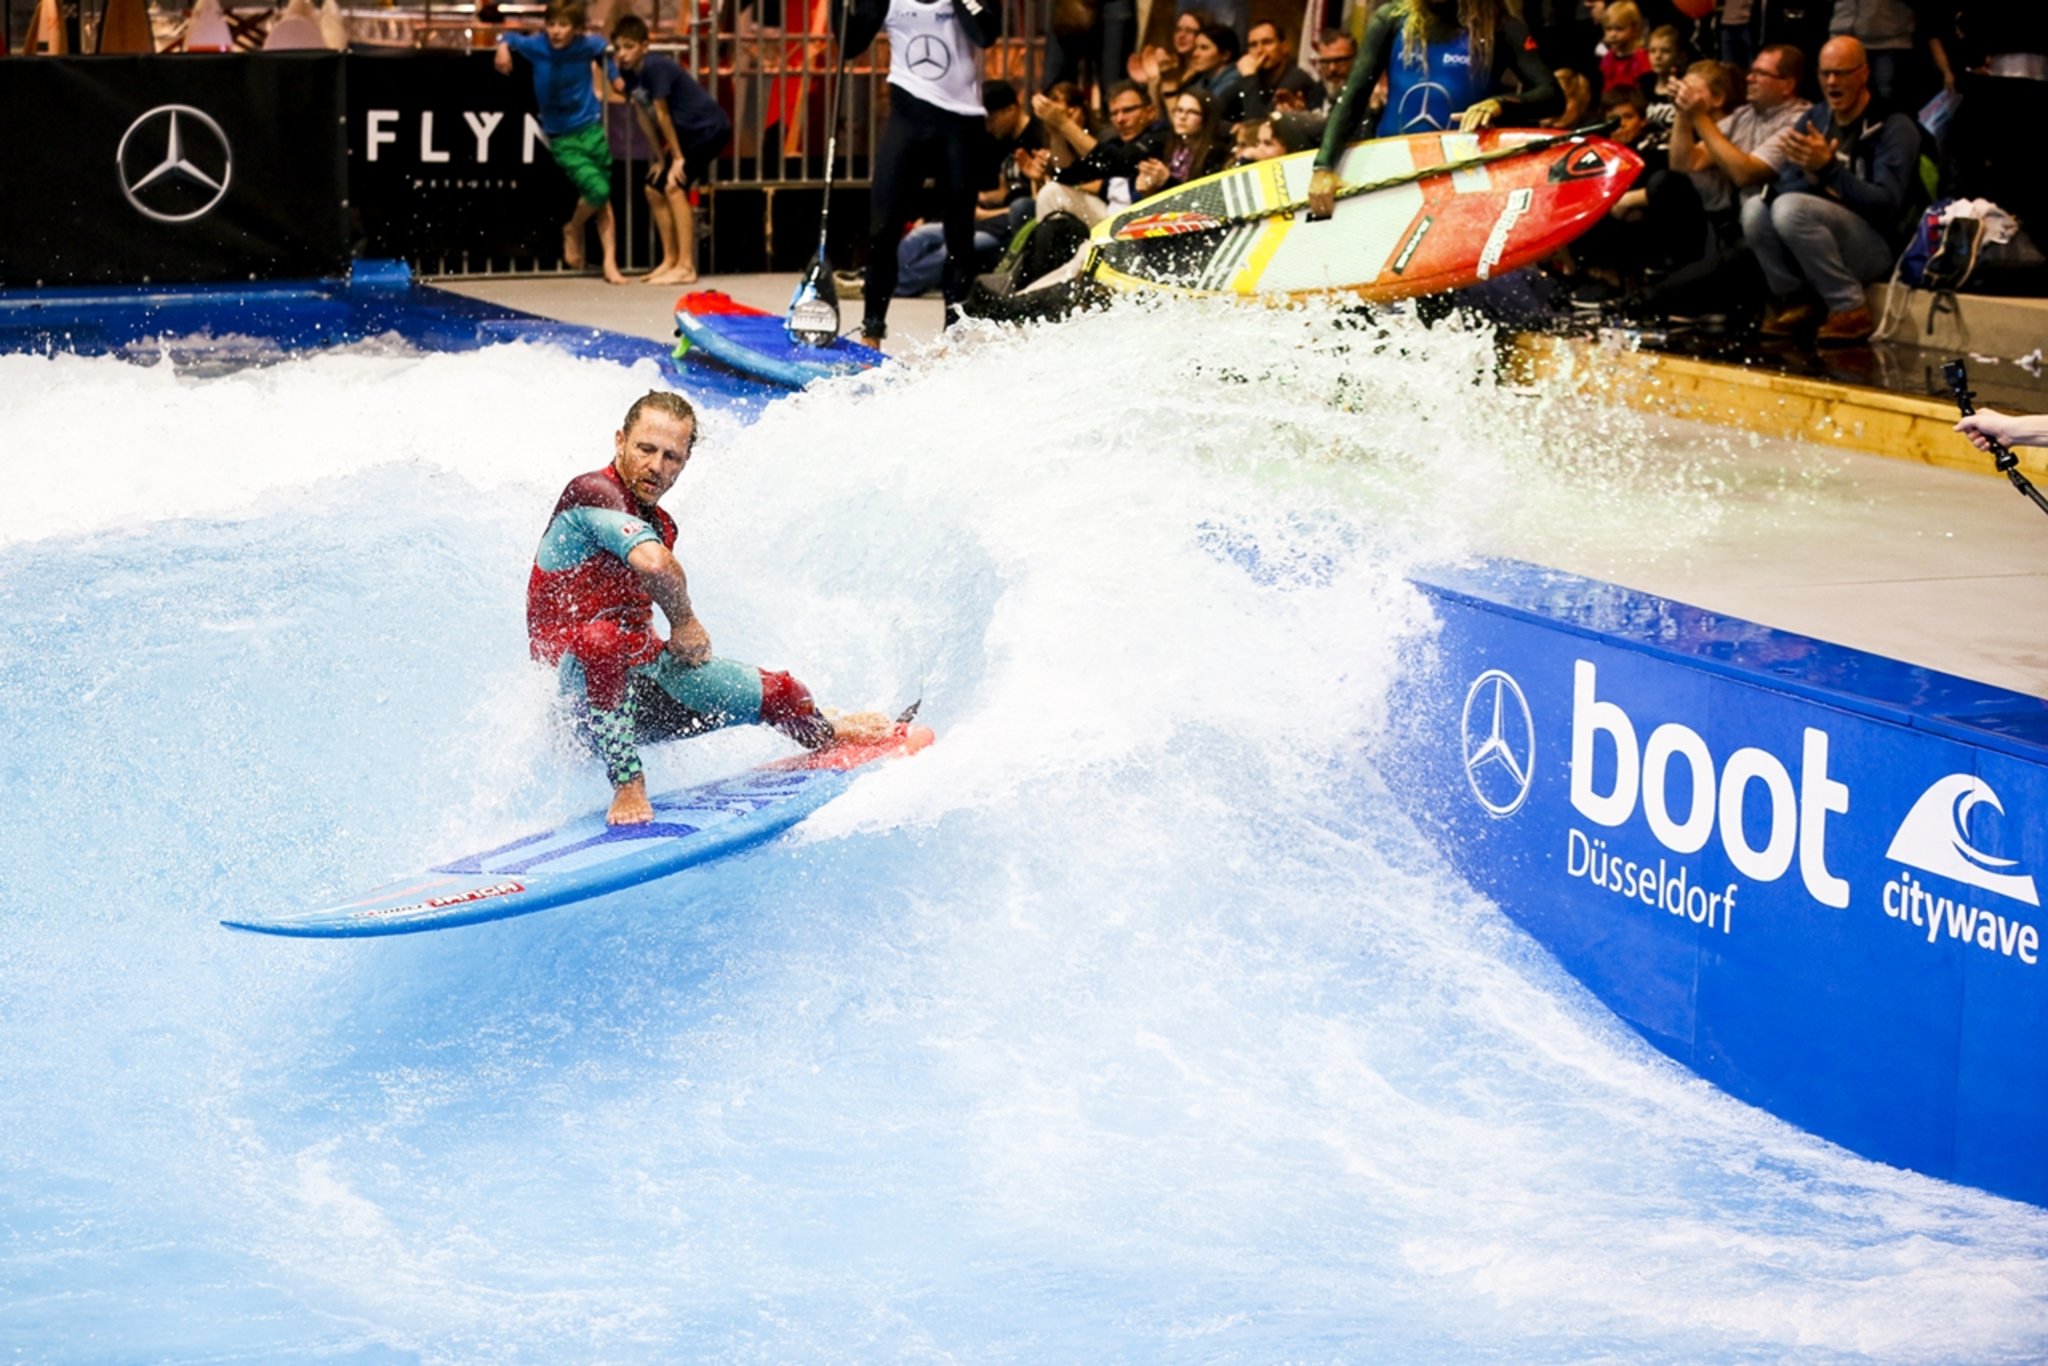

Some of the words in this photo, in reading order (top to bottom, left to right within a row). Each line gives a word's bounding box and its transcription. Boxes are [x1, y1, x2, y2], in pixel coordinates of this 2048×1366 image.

[1568, 658, 1850, 909] boot
[1567, 828, 1738, 934] Düsseldorf
[1882, 871, 2039, 964] citywave
